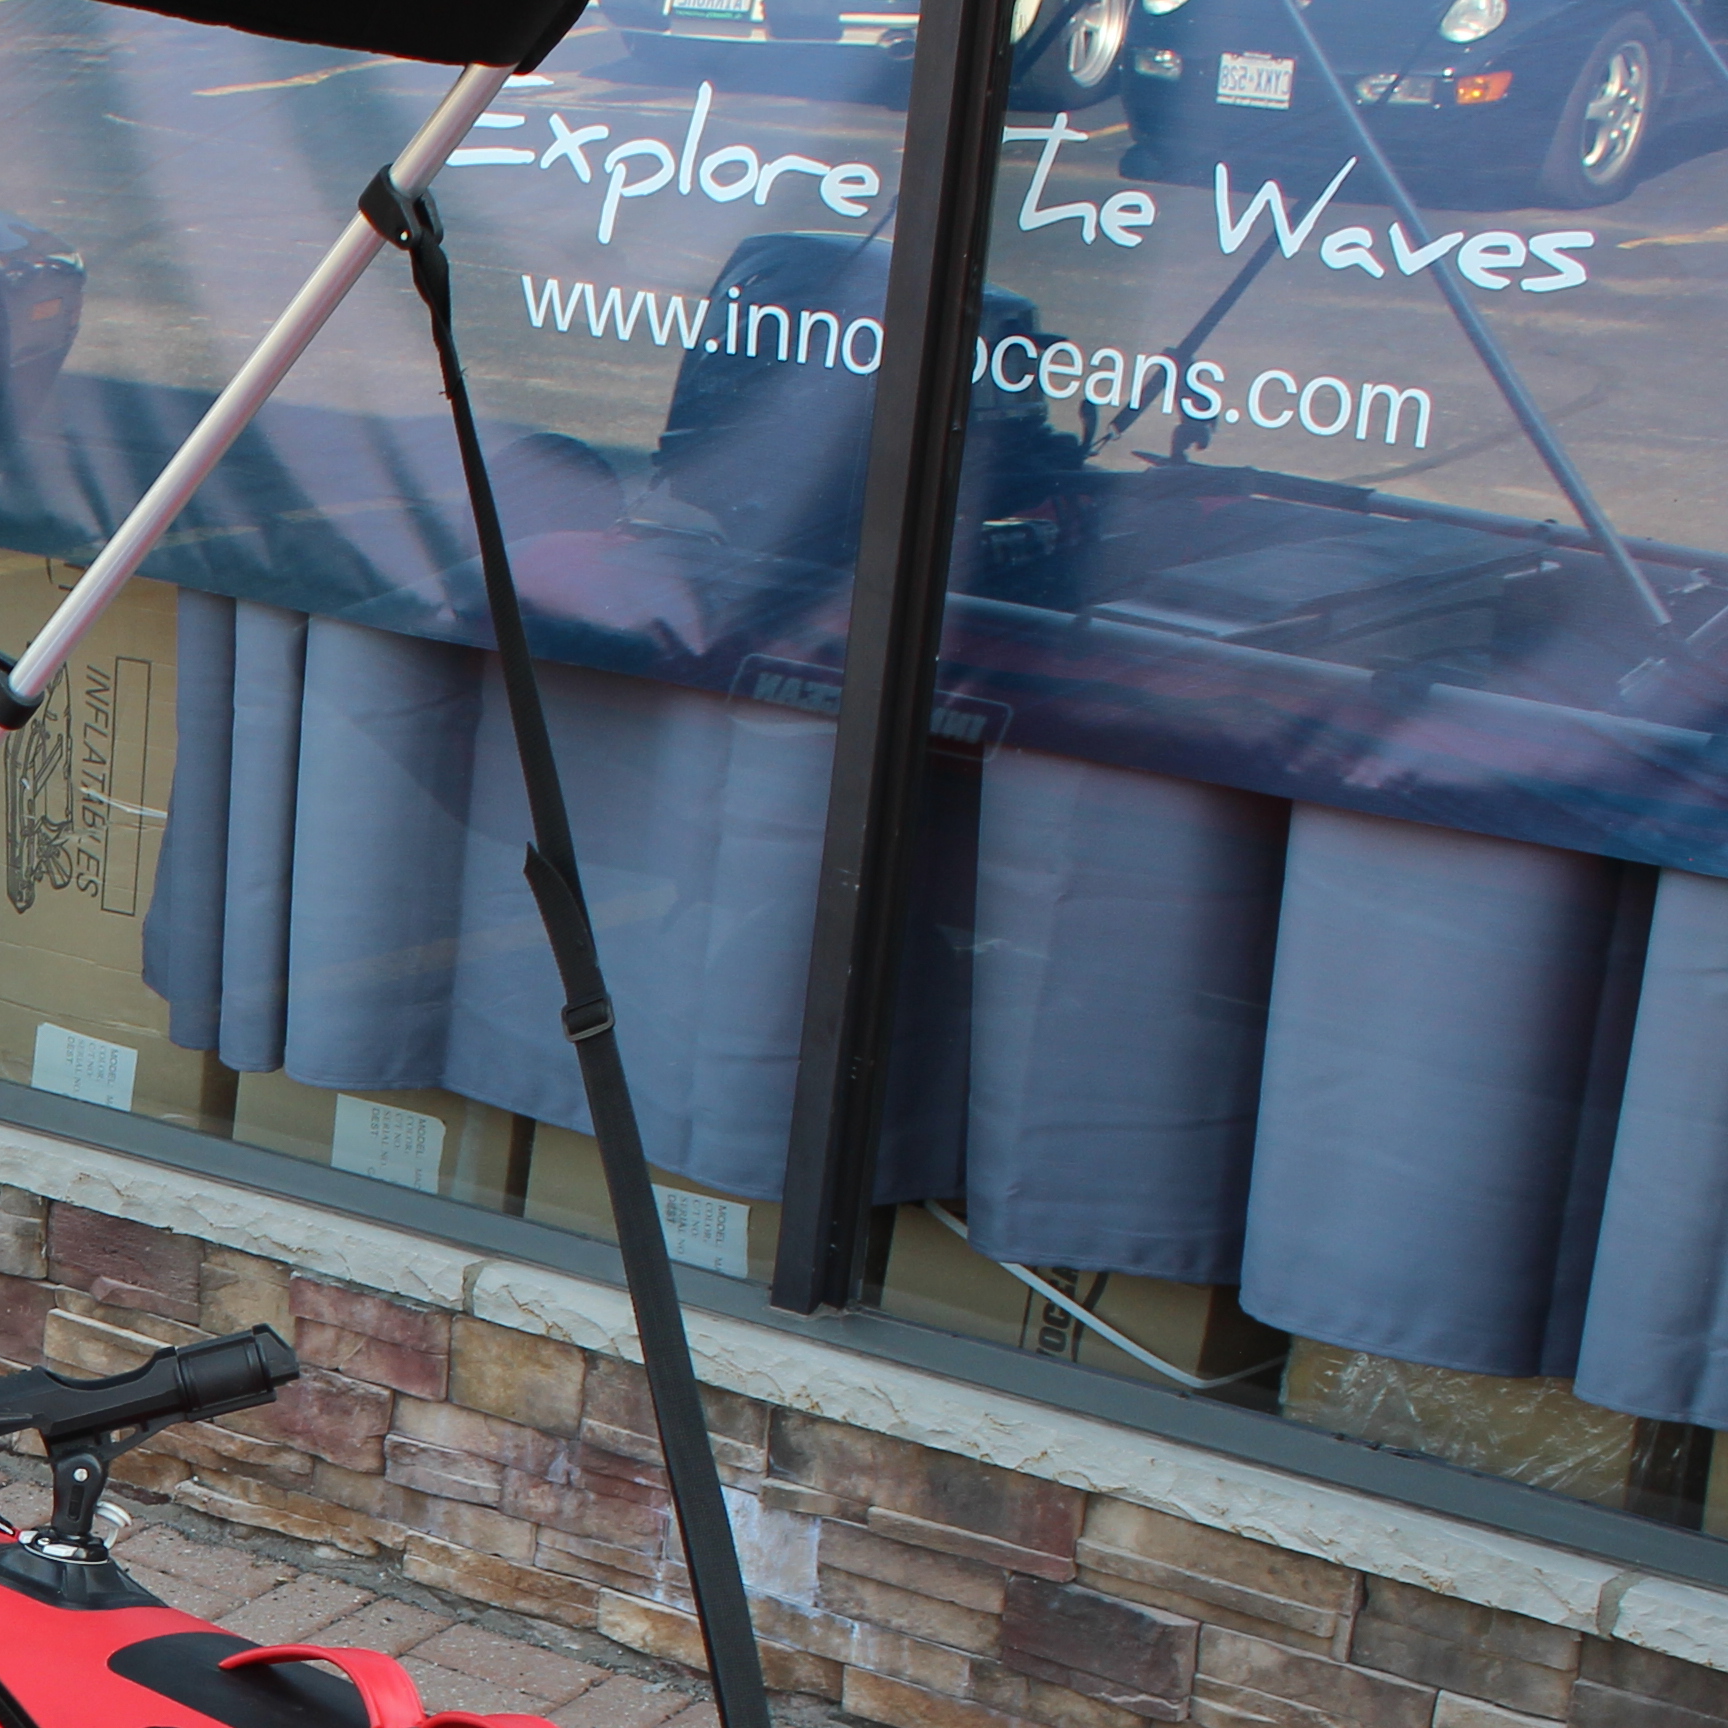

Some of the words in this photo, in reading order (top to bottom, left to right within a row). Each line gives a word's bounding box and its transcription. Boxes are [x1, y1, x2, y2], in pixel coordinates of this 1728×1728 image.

[445, 74, 881, 245] Explore
[1214, 155, 1597, 293] Waves
[520, 273, 1432, 450] www.innoceans.com
